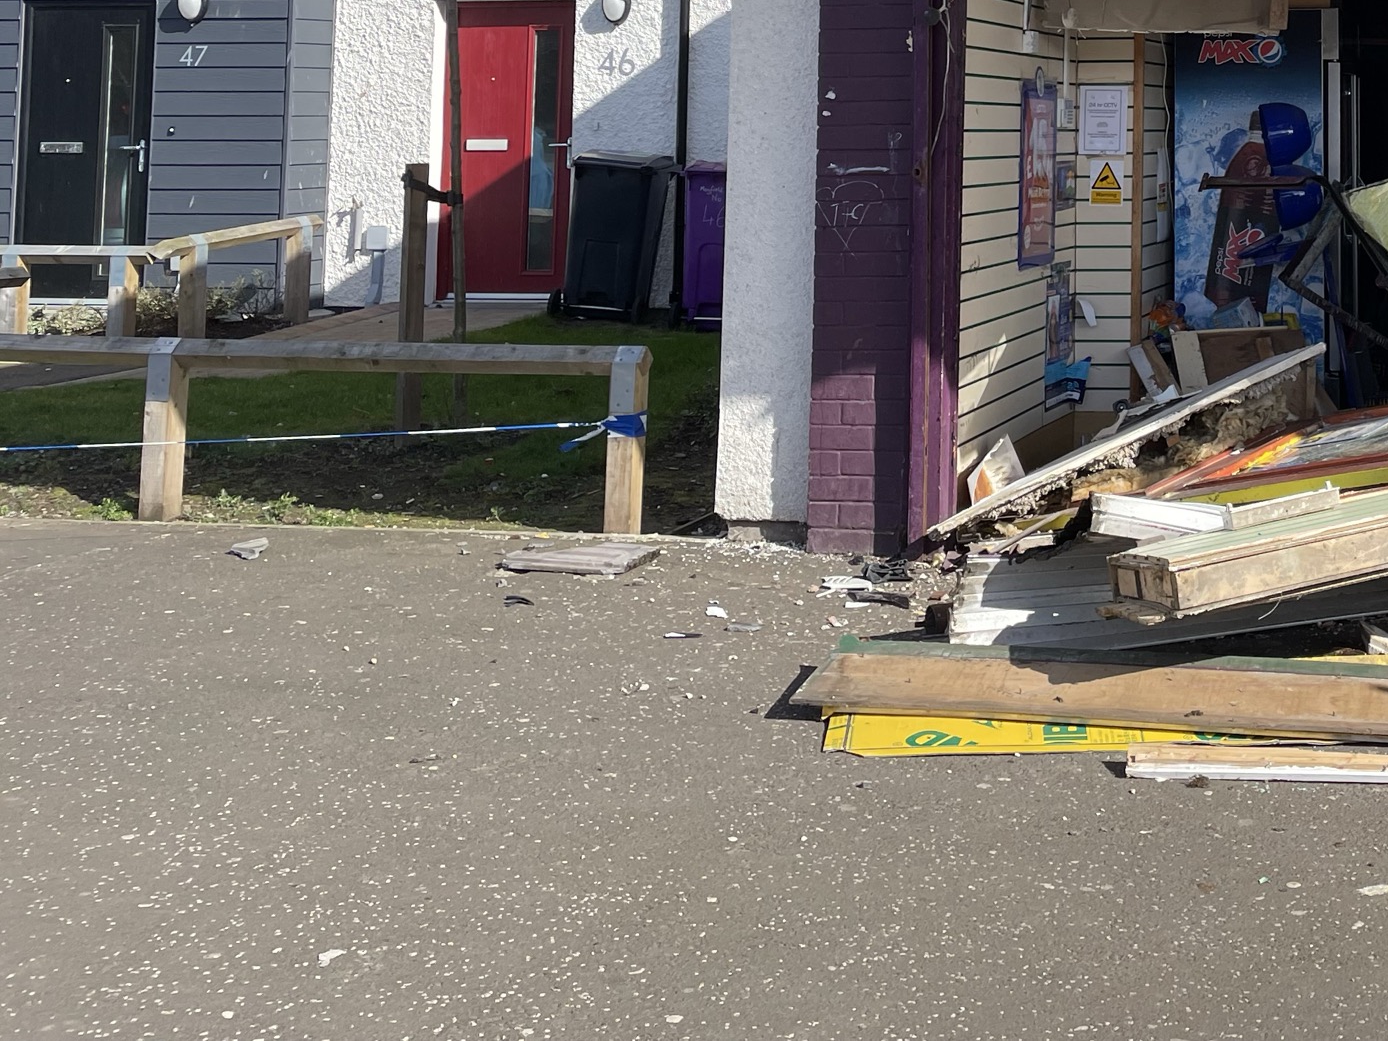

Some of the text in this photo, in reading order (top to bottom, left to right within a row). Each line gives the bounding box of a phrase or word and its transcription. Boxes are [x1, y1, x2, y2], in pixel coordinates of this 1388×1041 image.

[179, 45, 208, 66] 47
[597, 48, 635, 76] 46
[1198, 40, 1260, 65] MAX
[702, 205, 725, 228] 46
[1214, 247, 1224, 275] pepsi
[1222, 221, 1254, 285] MAX
